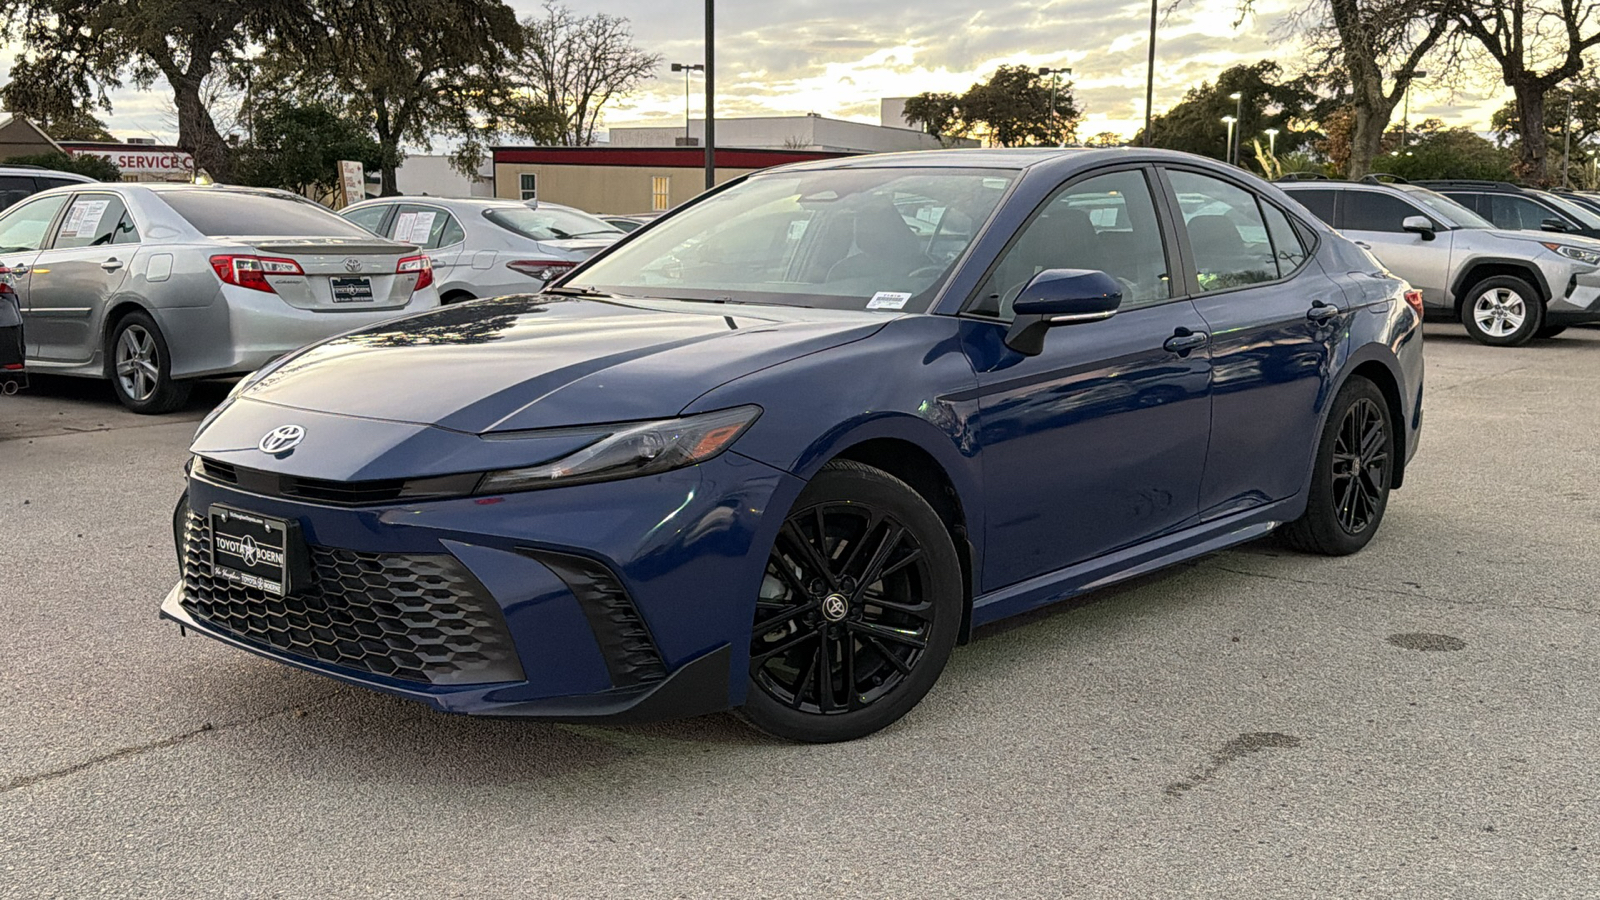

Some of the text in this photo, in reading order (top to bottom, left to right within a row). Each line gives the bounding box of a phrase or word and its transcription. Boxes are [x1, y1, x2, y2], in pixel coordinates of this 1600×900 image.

[119, 155, 179, 169] SERVICE
[216, 537, 284, 564] TOYOTA BOERN
